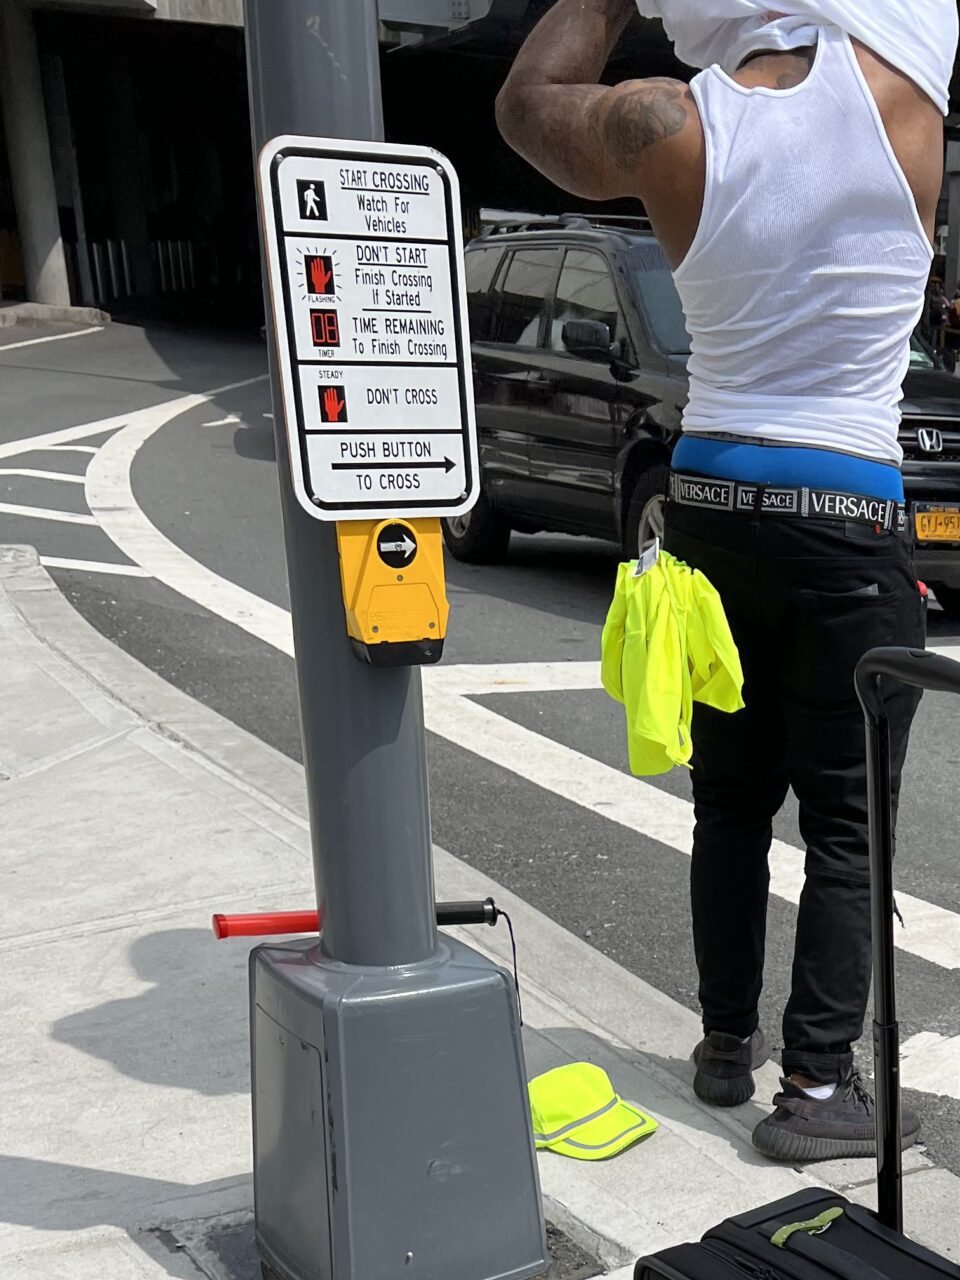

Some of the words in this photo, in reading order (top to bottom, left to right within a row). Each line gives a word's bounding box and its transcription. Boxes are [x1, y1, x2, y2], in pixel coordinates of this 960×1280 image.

[339, 169, 367, 187] START
[372, 172, 430, 192] CROSSING
[357, 194, 388, 213] Watch
[395, 199, 410, 214] For
[365, 215, 407, 233] Vehicles
[356, 245, 389, 263] DON'T
[396, 247, 427, 264] START
[355, 268, 385, 286] Finish
[391, 271, 433, 292] Crossing
[308, 295, 336, 304] FLASHING
[372, 289, 380, 305] If
[385, 290, 421, 307] Started
[352, 317, 377, 334] TIME
[385, 318, 445, 336] REMAINING
[318, 349, 335, 358] TIMER
[352, 338, 364, 355] To
[372, 339, 400, 355] Finish
[407, 341, 447, 360] Crossing
[319, 370, 343, 379] STEADY
[366, 389, 399, 405] DON'T
[405, 389, 438, 405] CROSS
[340, 442, 376, 458] PUSH
[383, 442, 432, 457] BUTTON
[356, 474, 372, 490] TO
[379, 474, 421, 489] CROSS
[680, 481, 729, 503] VERSACE
[741, 491, 793, 507] VESACE
[811, 492, 886, 523] VERSACE
